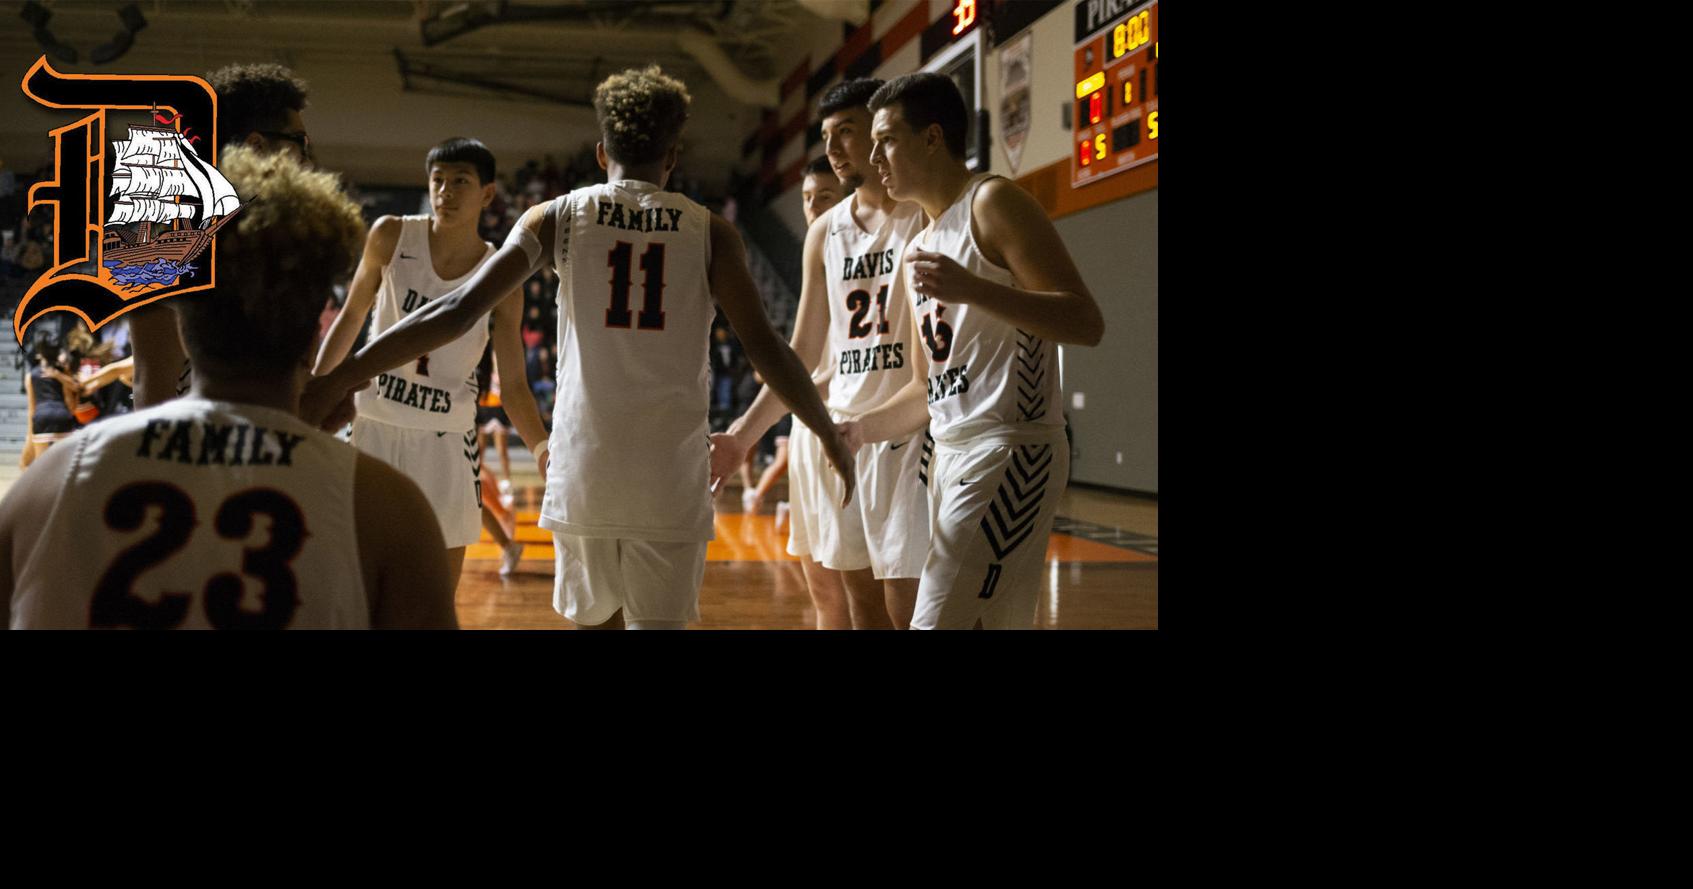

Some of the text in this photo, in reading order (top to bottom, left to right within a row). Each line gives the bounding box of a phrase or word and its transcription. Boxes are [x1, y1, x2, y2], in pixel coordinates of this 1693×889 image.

[1113, 10, 1149, 58] 8:00
[596, 201, 683, 233] FAMILY
[605, 240, 667, 331] 11
[842, 249, 894, 281] DAVIS
[846, 284, 890, 339] 21
[840, 342, 904, 375] PIRATES
[377, 373, 452, 413] PIRATES
[137, 419, 304, 467] FAMILY
[88, 480, 312, 630] 23
